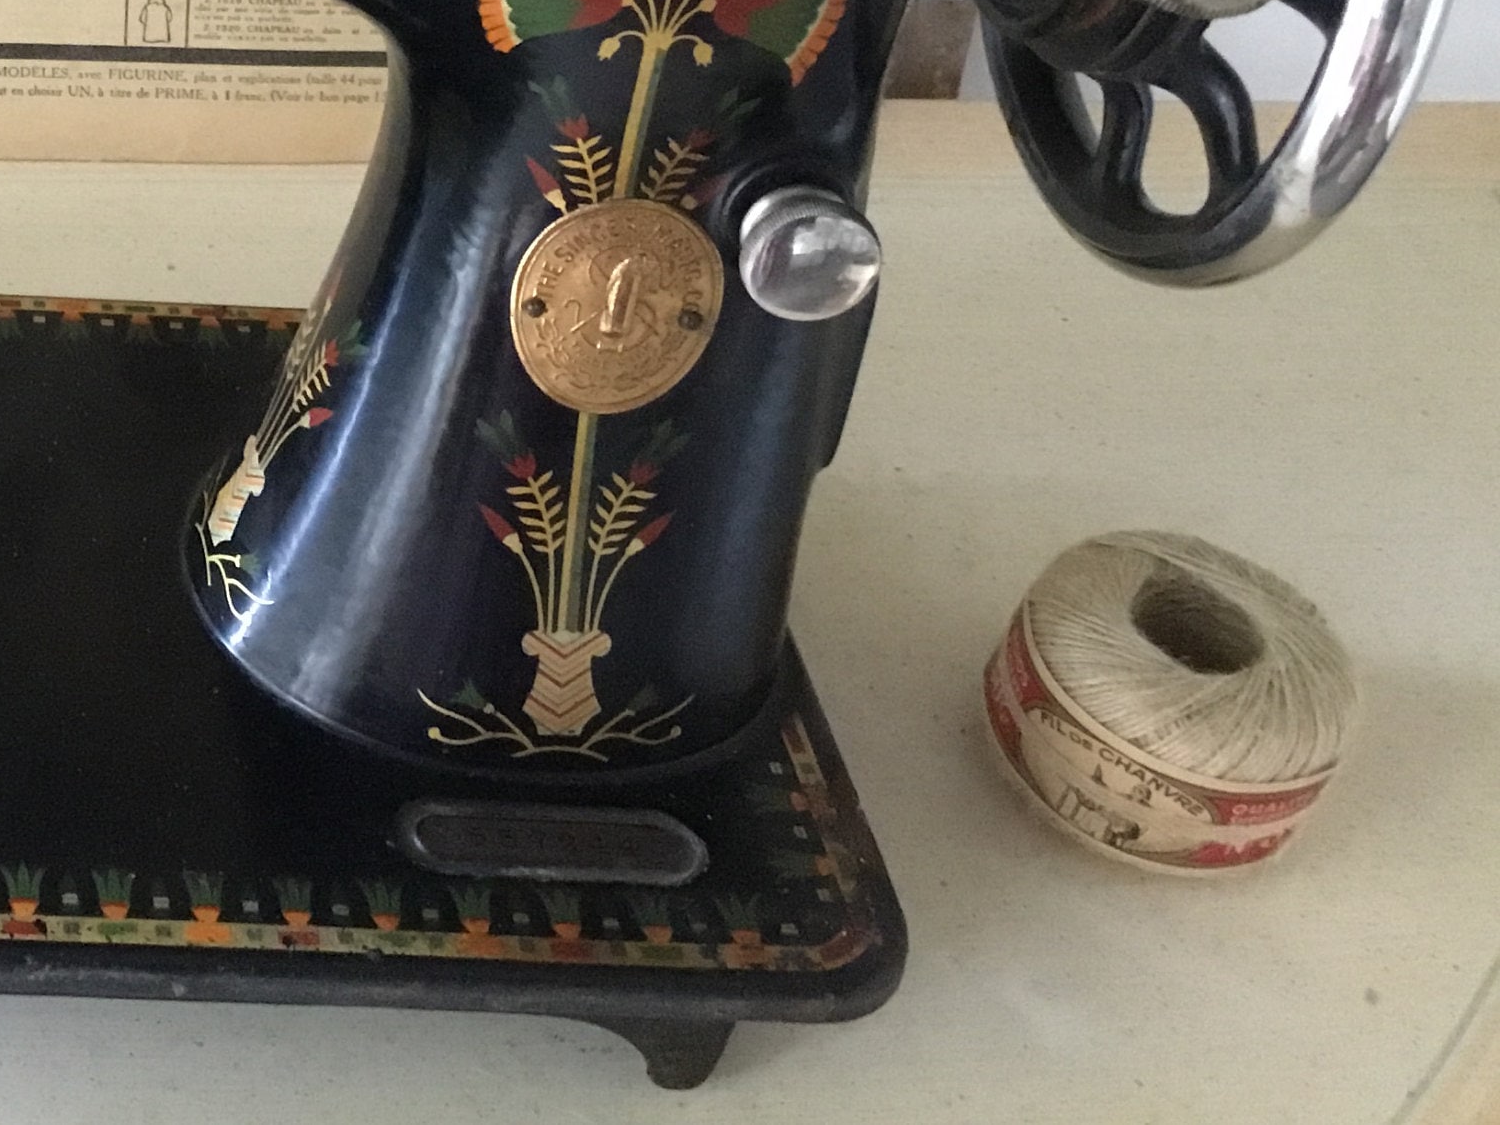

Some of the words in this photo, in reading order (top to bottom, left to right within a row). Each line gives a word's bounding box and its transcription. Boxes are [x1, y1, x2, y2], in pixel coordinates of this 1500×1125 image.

[11, 87, 24, 96] en
[136, 86, 151, 98] de
[1040, 710, 1068, 737] FIL
[1098, 746, 1204, 818] CHANVRE
